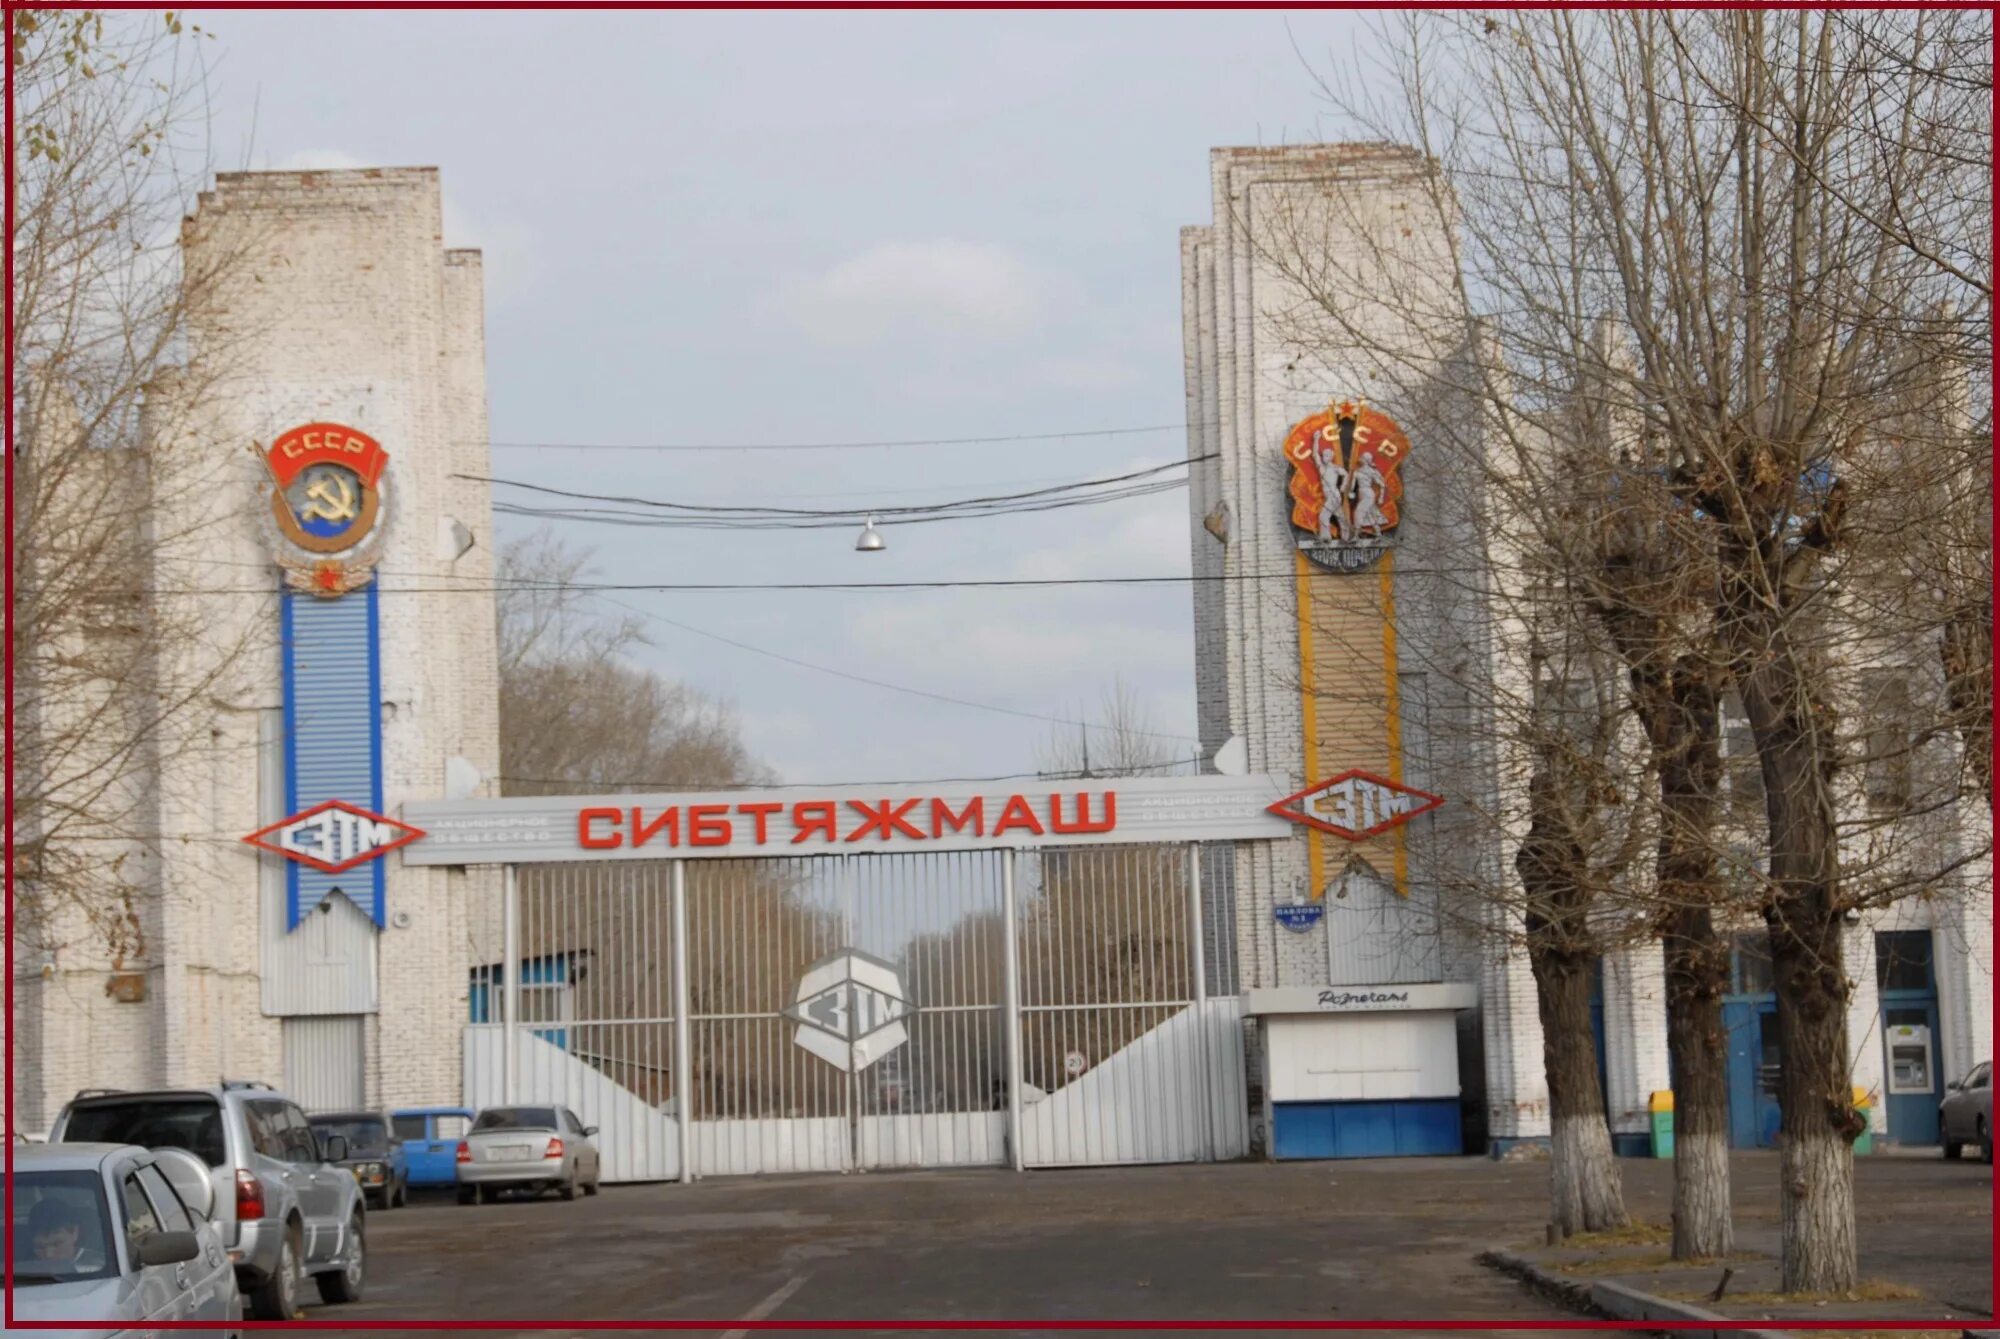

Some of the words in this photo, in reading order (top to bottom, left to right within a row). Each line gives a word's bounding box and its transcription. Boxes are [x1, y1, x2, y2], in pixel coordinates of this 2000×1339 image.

[281, 431, 366, 459] СССР
[1292, 423, 1398, 461] СССР
[577, 790, 1117, 850] СИБТЯЖМАШ
